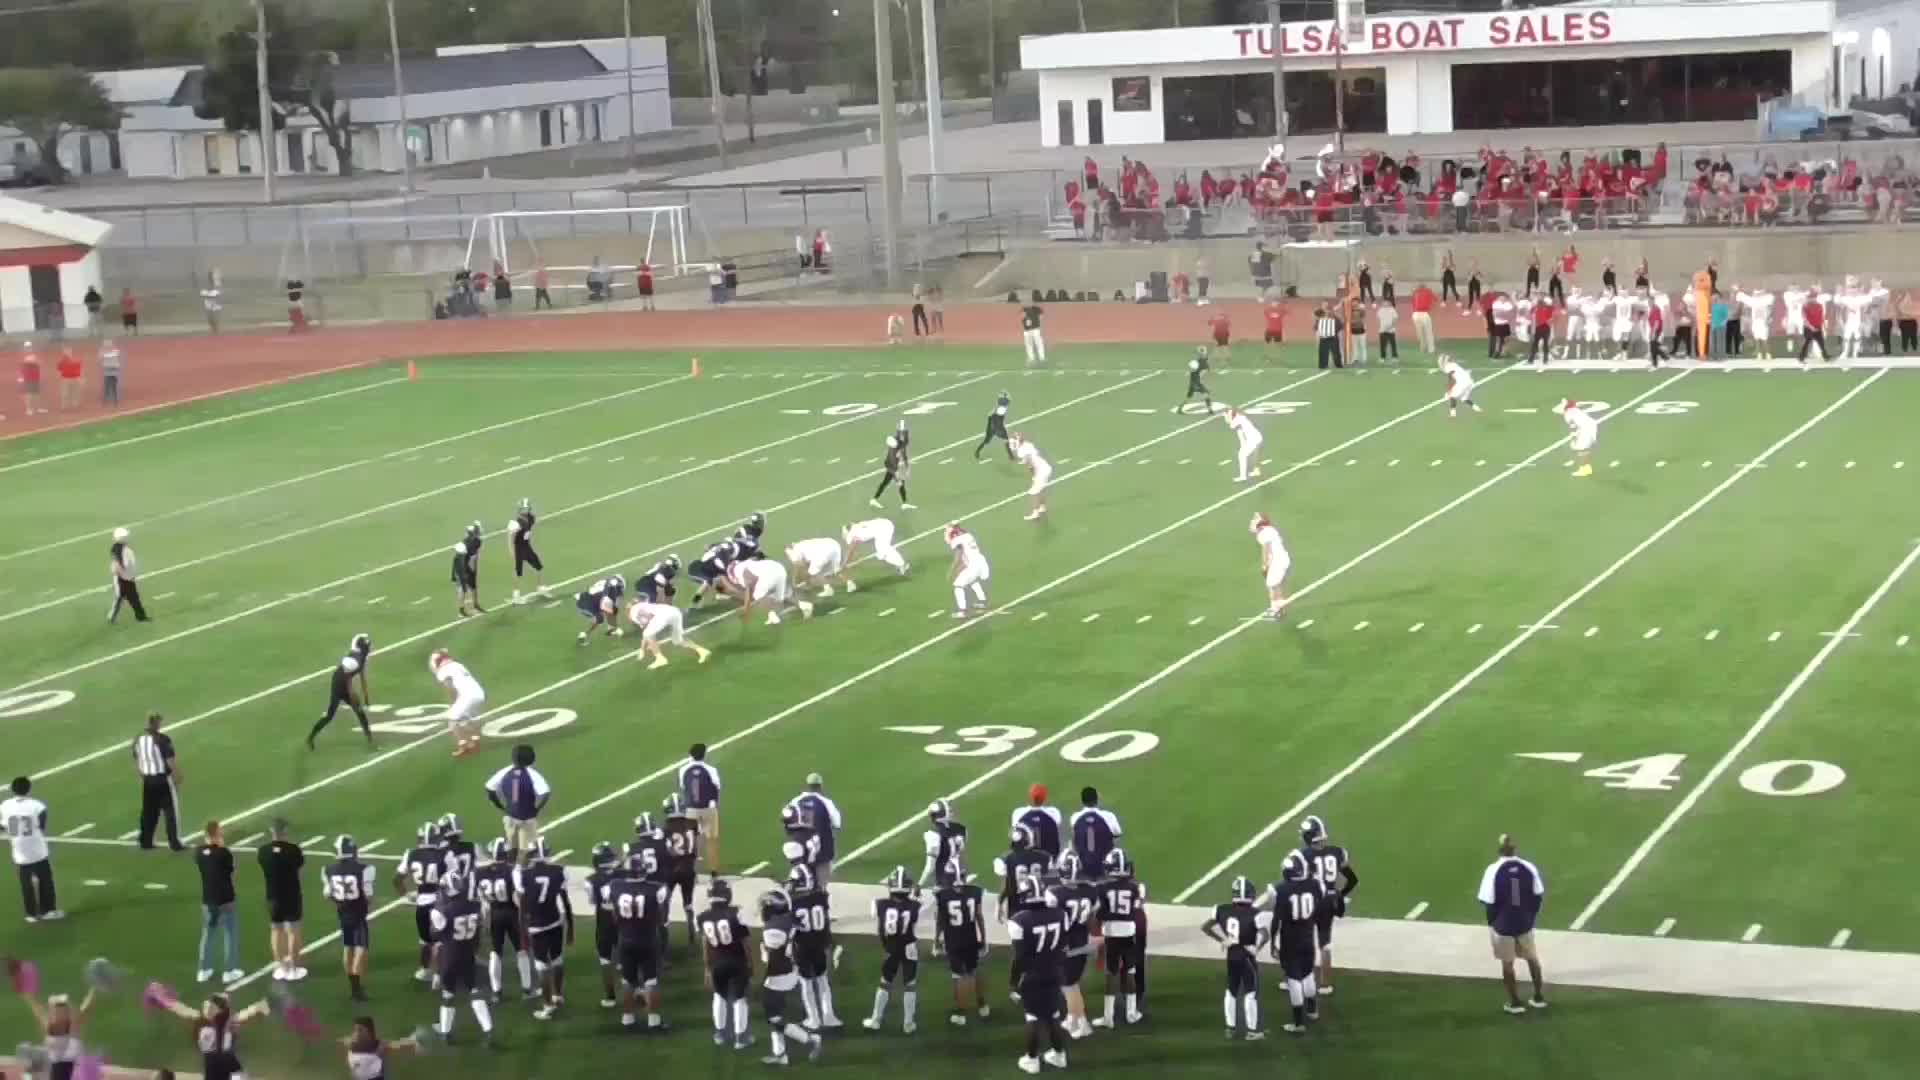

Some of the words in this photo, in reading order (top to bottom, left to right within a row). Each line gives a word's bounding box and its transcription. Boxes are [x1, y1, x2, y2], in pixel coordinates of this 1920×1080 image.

[1233, 26, 1347, 56] TULSA
[1371, 19, 1464, 50] BOAT
[1489, 11, 1611, 44] SALES
[1313, 855, 1336, 882] 19
[330, 875, 360, 901] 53
[535, 876, 550, 904] 7
[1107, 889, 1132, 915] 15
[795, 905, 825, 932] 30
[947, 898, 976, 927] 51
[1289, 892, 1315, 921] 10
[453, 913, 478, 941] 55
[1032, 922, 1061, 953] 77
